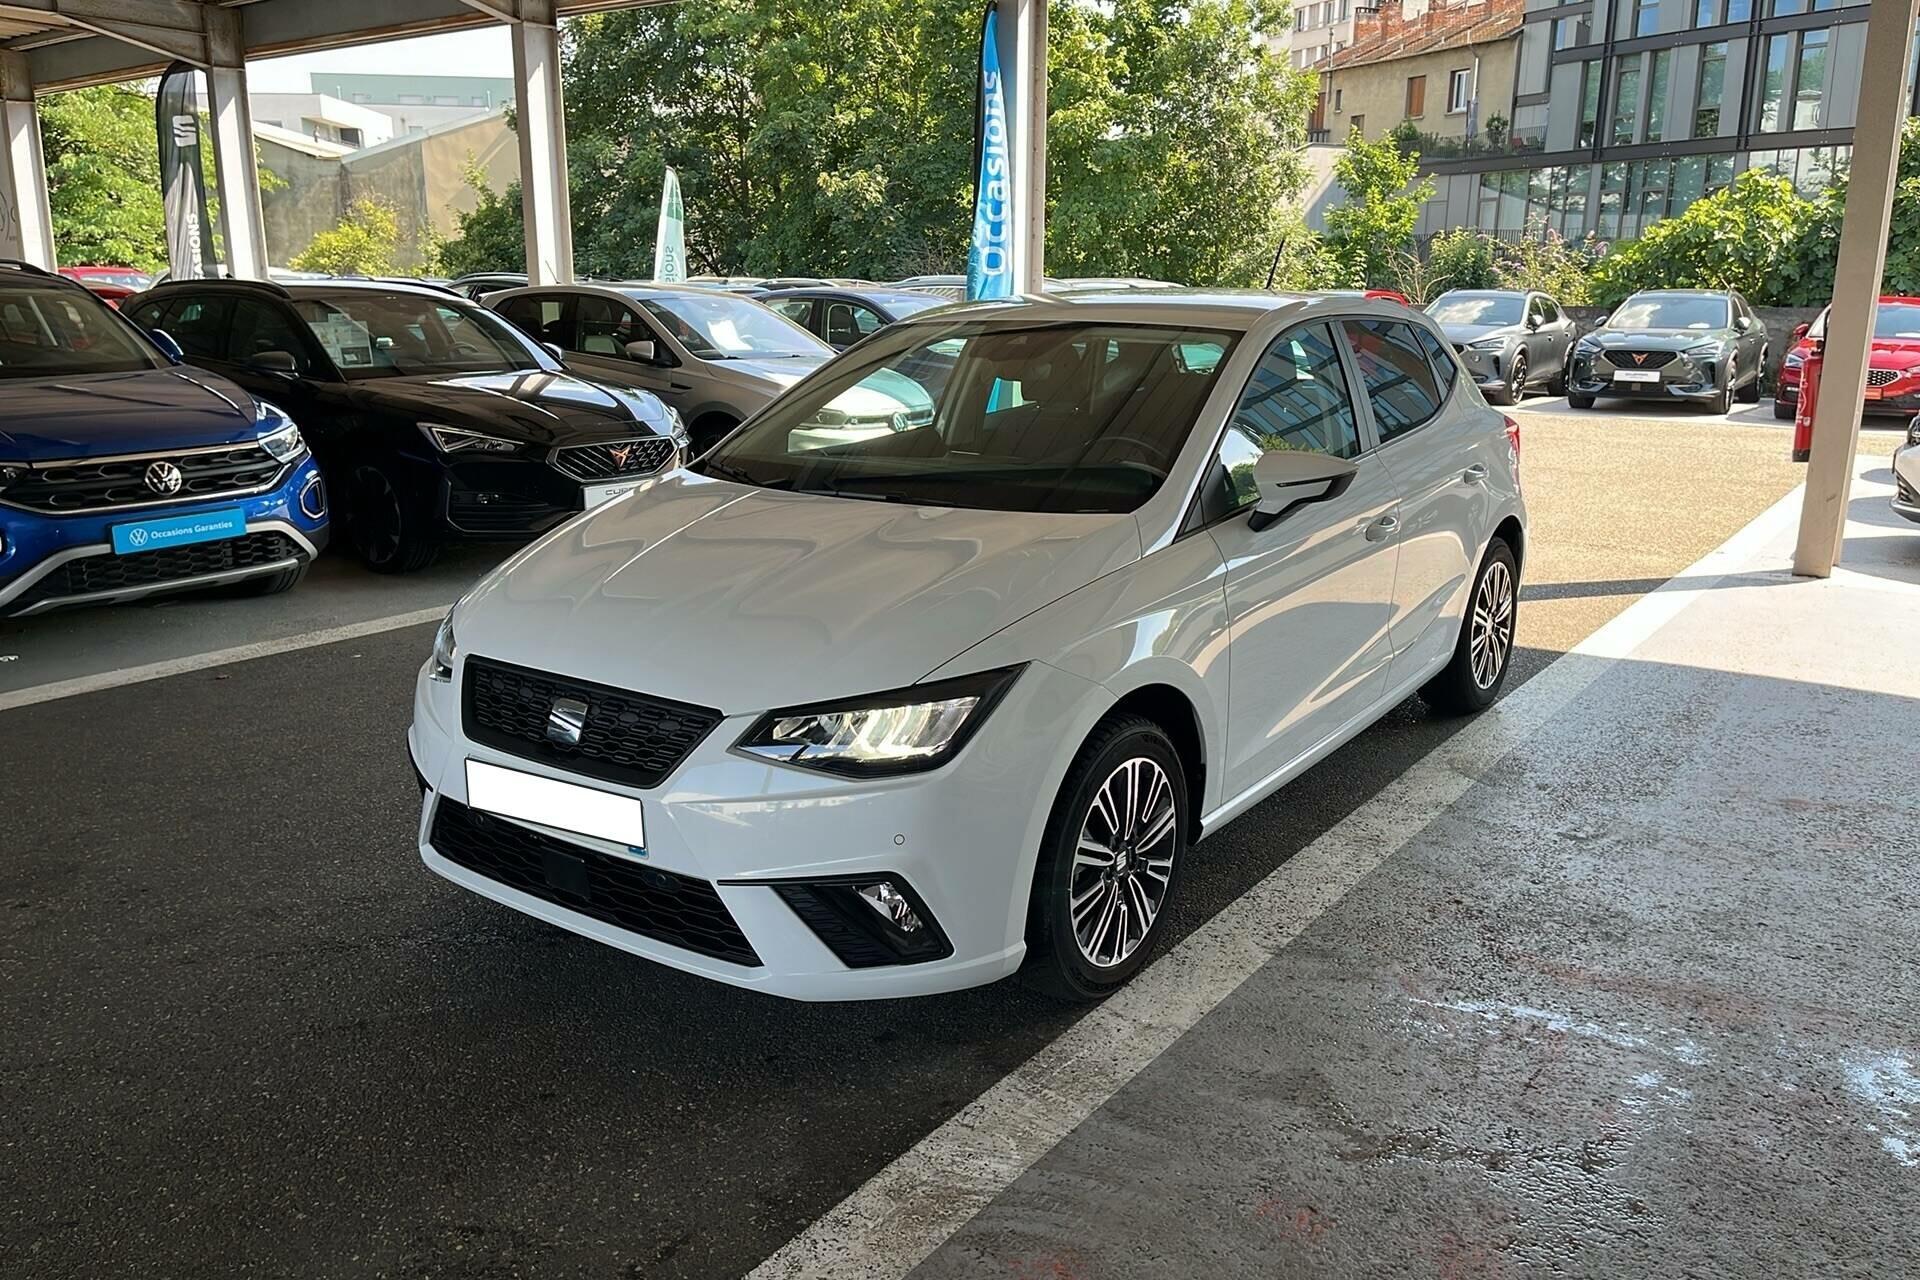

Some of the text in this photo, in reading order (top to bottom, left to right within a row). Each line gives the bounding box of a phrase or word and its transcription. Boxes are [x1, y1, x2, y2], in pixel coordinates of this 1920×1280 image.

[982, 71, 1007, 276] Occasions
[151, 527, 193, 539] Occasions
[194, 521, 233, 532] Garanties
